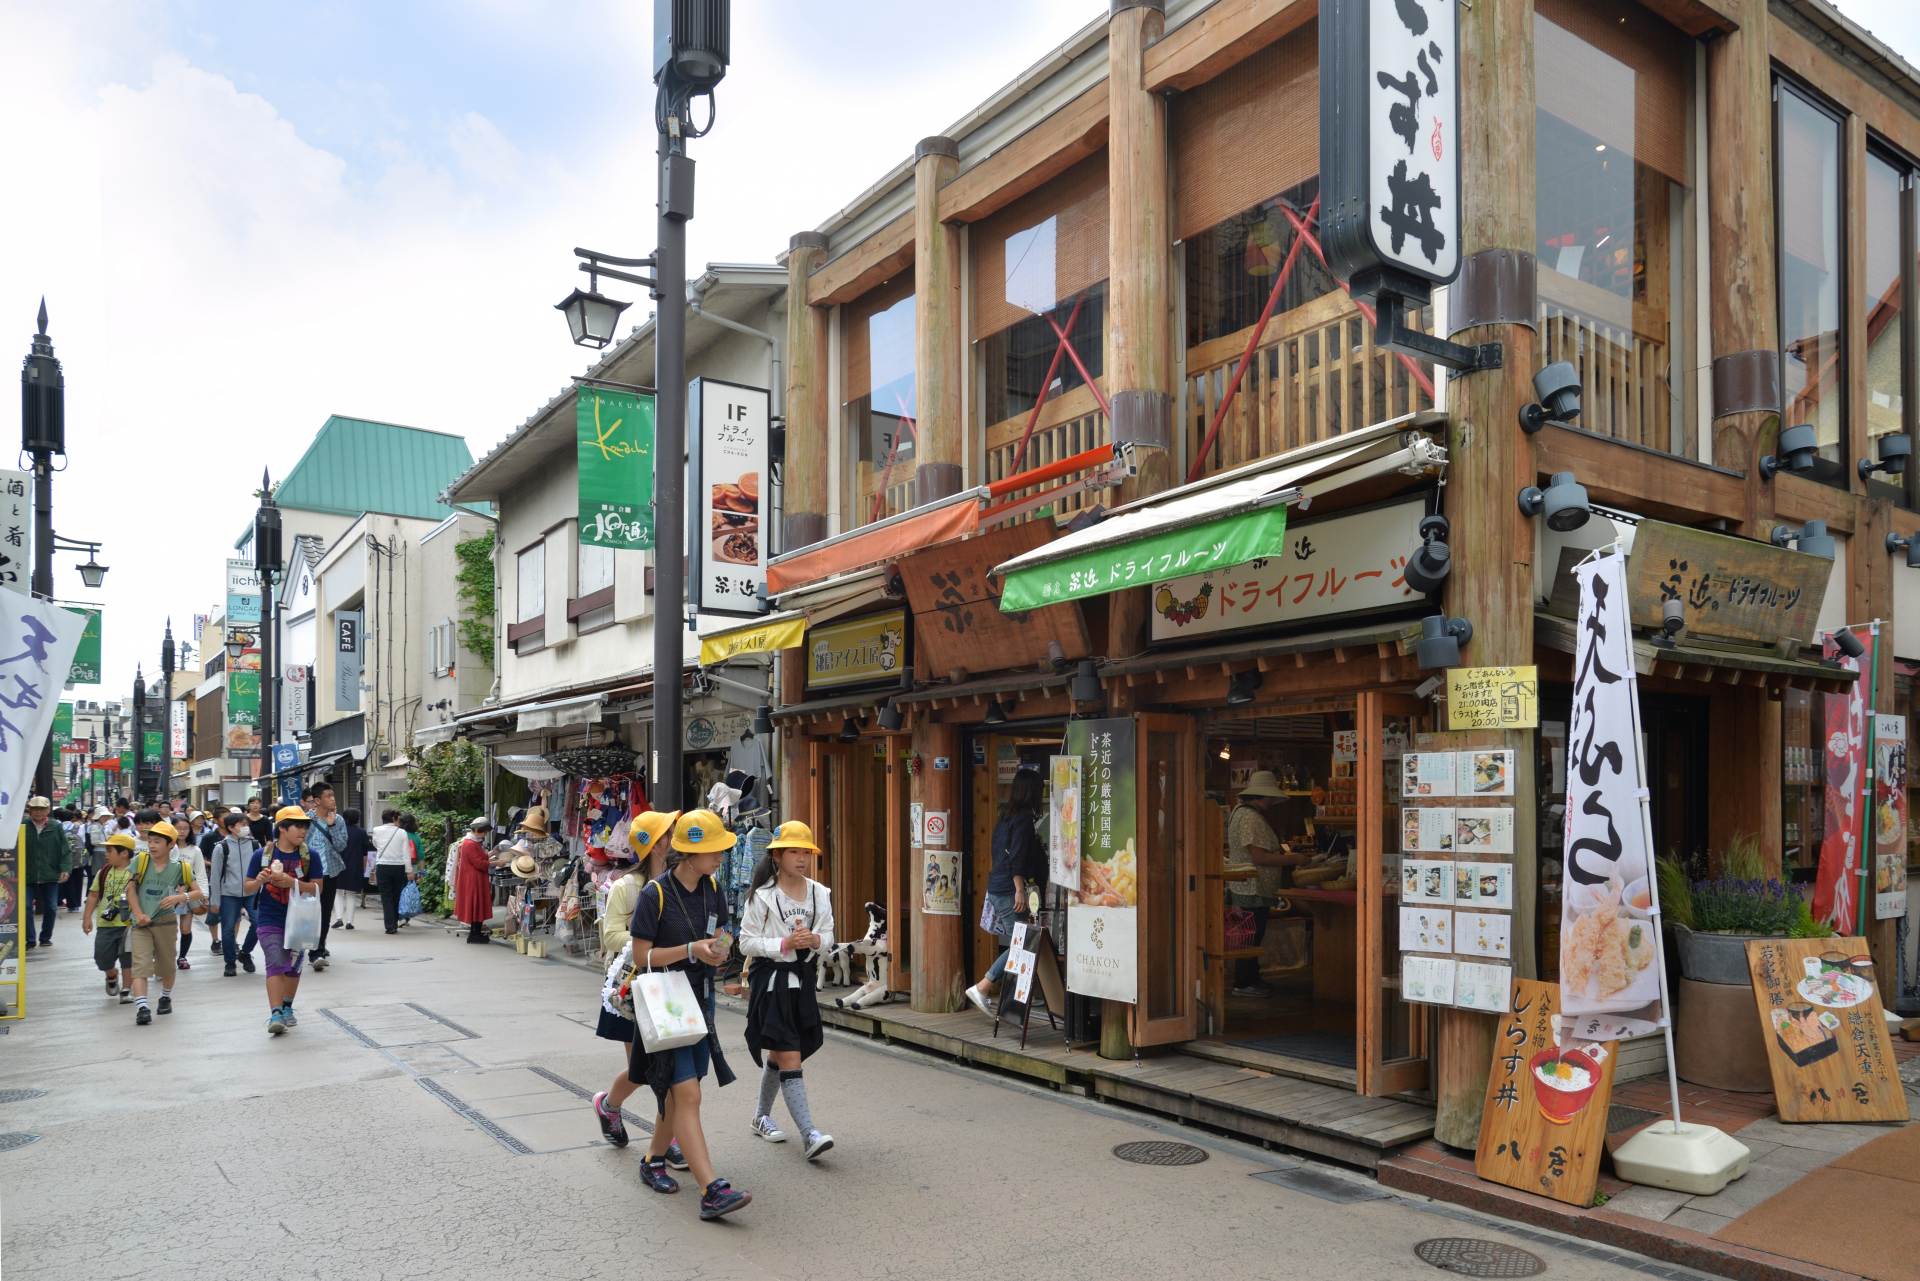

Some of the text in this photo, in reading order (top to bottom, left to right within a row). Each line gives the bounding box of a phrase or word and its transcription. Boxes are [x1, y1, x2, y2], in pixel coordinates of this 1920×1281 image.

[1110, 542, 1227, 583] ドライフルーツ
[1729, 577, 1800, 610] ドライフルーツ
[341, 622, 354, 650] CAFÉ
[1088, 732, 1100, 847] ドライフルーツ
[1100, 732, 1112, 848] 茶近の厳選国産
[1492, 986, 1532, 1112] しらす丼
